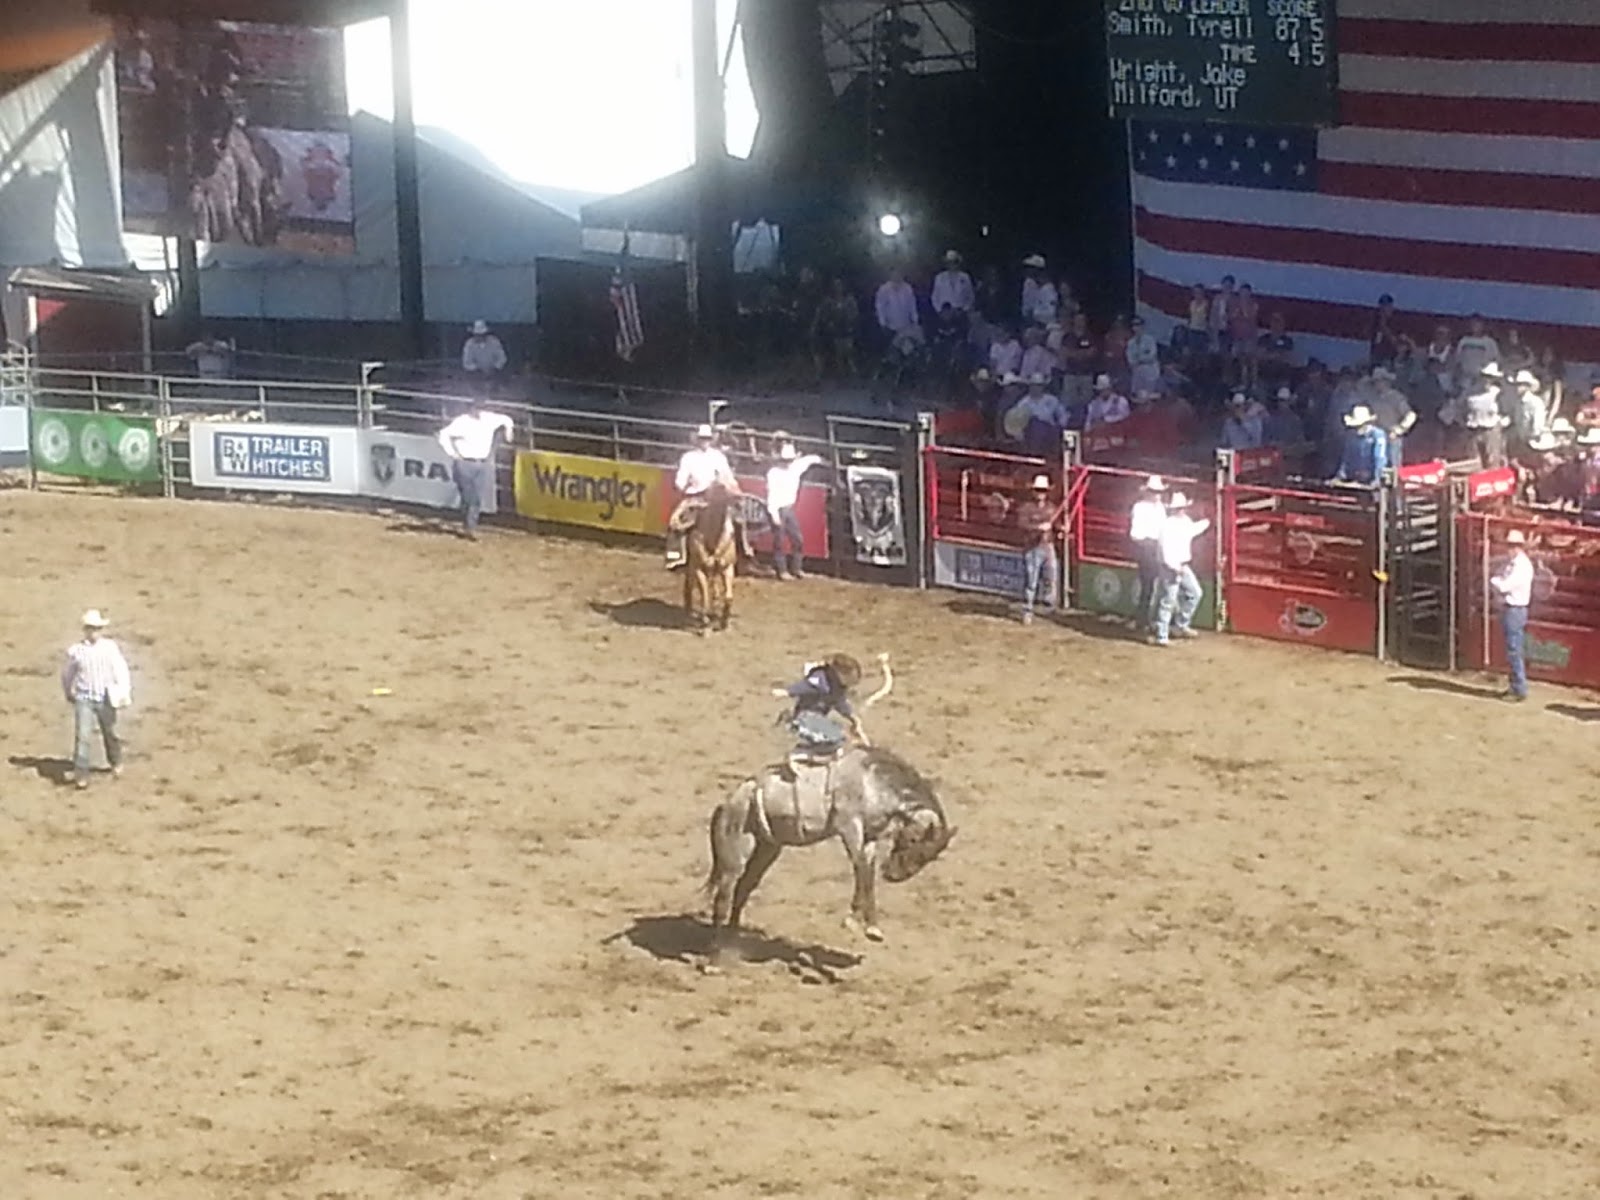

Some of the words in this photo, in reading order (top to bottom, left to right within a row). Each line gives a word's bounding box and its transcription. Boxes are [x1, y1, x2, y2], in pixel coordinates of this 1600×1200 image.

[1267, 0, 1318, 18] SCORE
[1108, 11, 1173, 35] Smith,
[1187, 14, 1252, 39] Tyrell
[1219, 44, 1257, 63] TIME
[1115, 81, 1201, 108] Milford,
[1214, 86, 1239, 109] UT
[252, 437, 323, 457] TRAILER
[252, 457, 325, 478] HITCHES
[404, 458, 451, 482] RA
[534, 461, 646, 521] Wrangler
